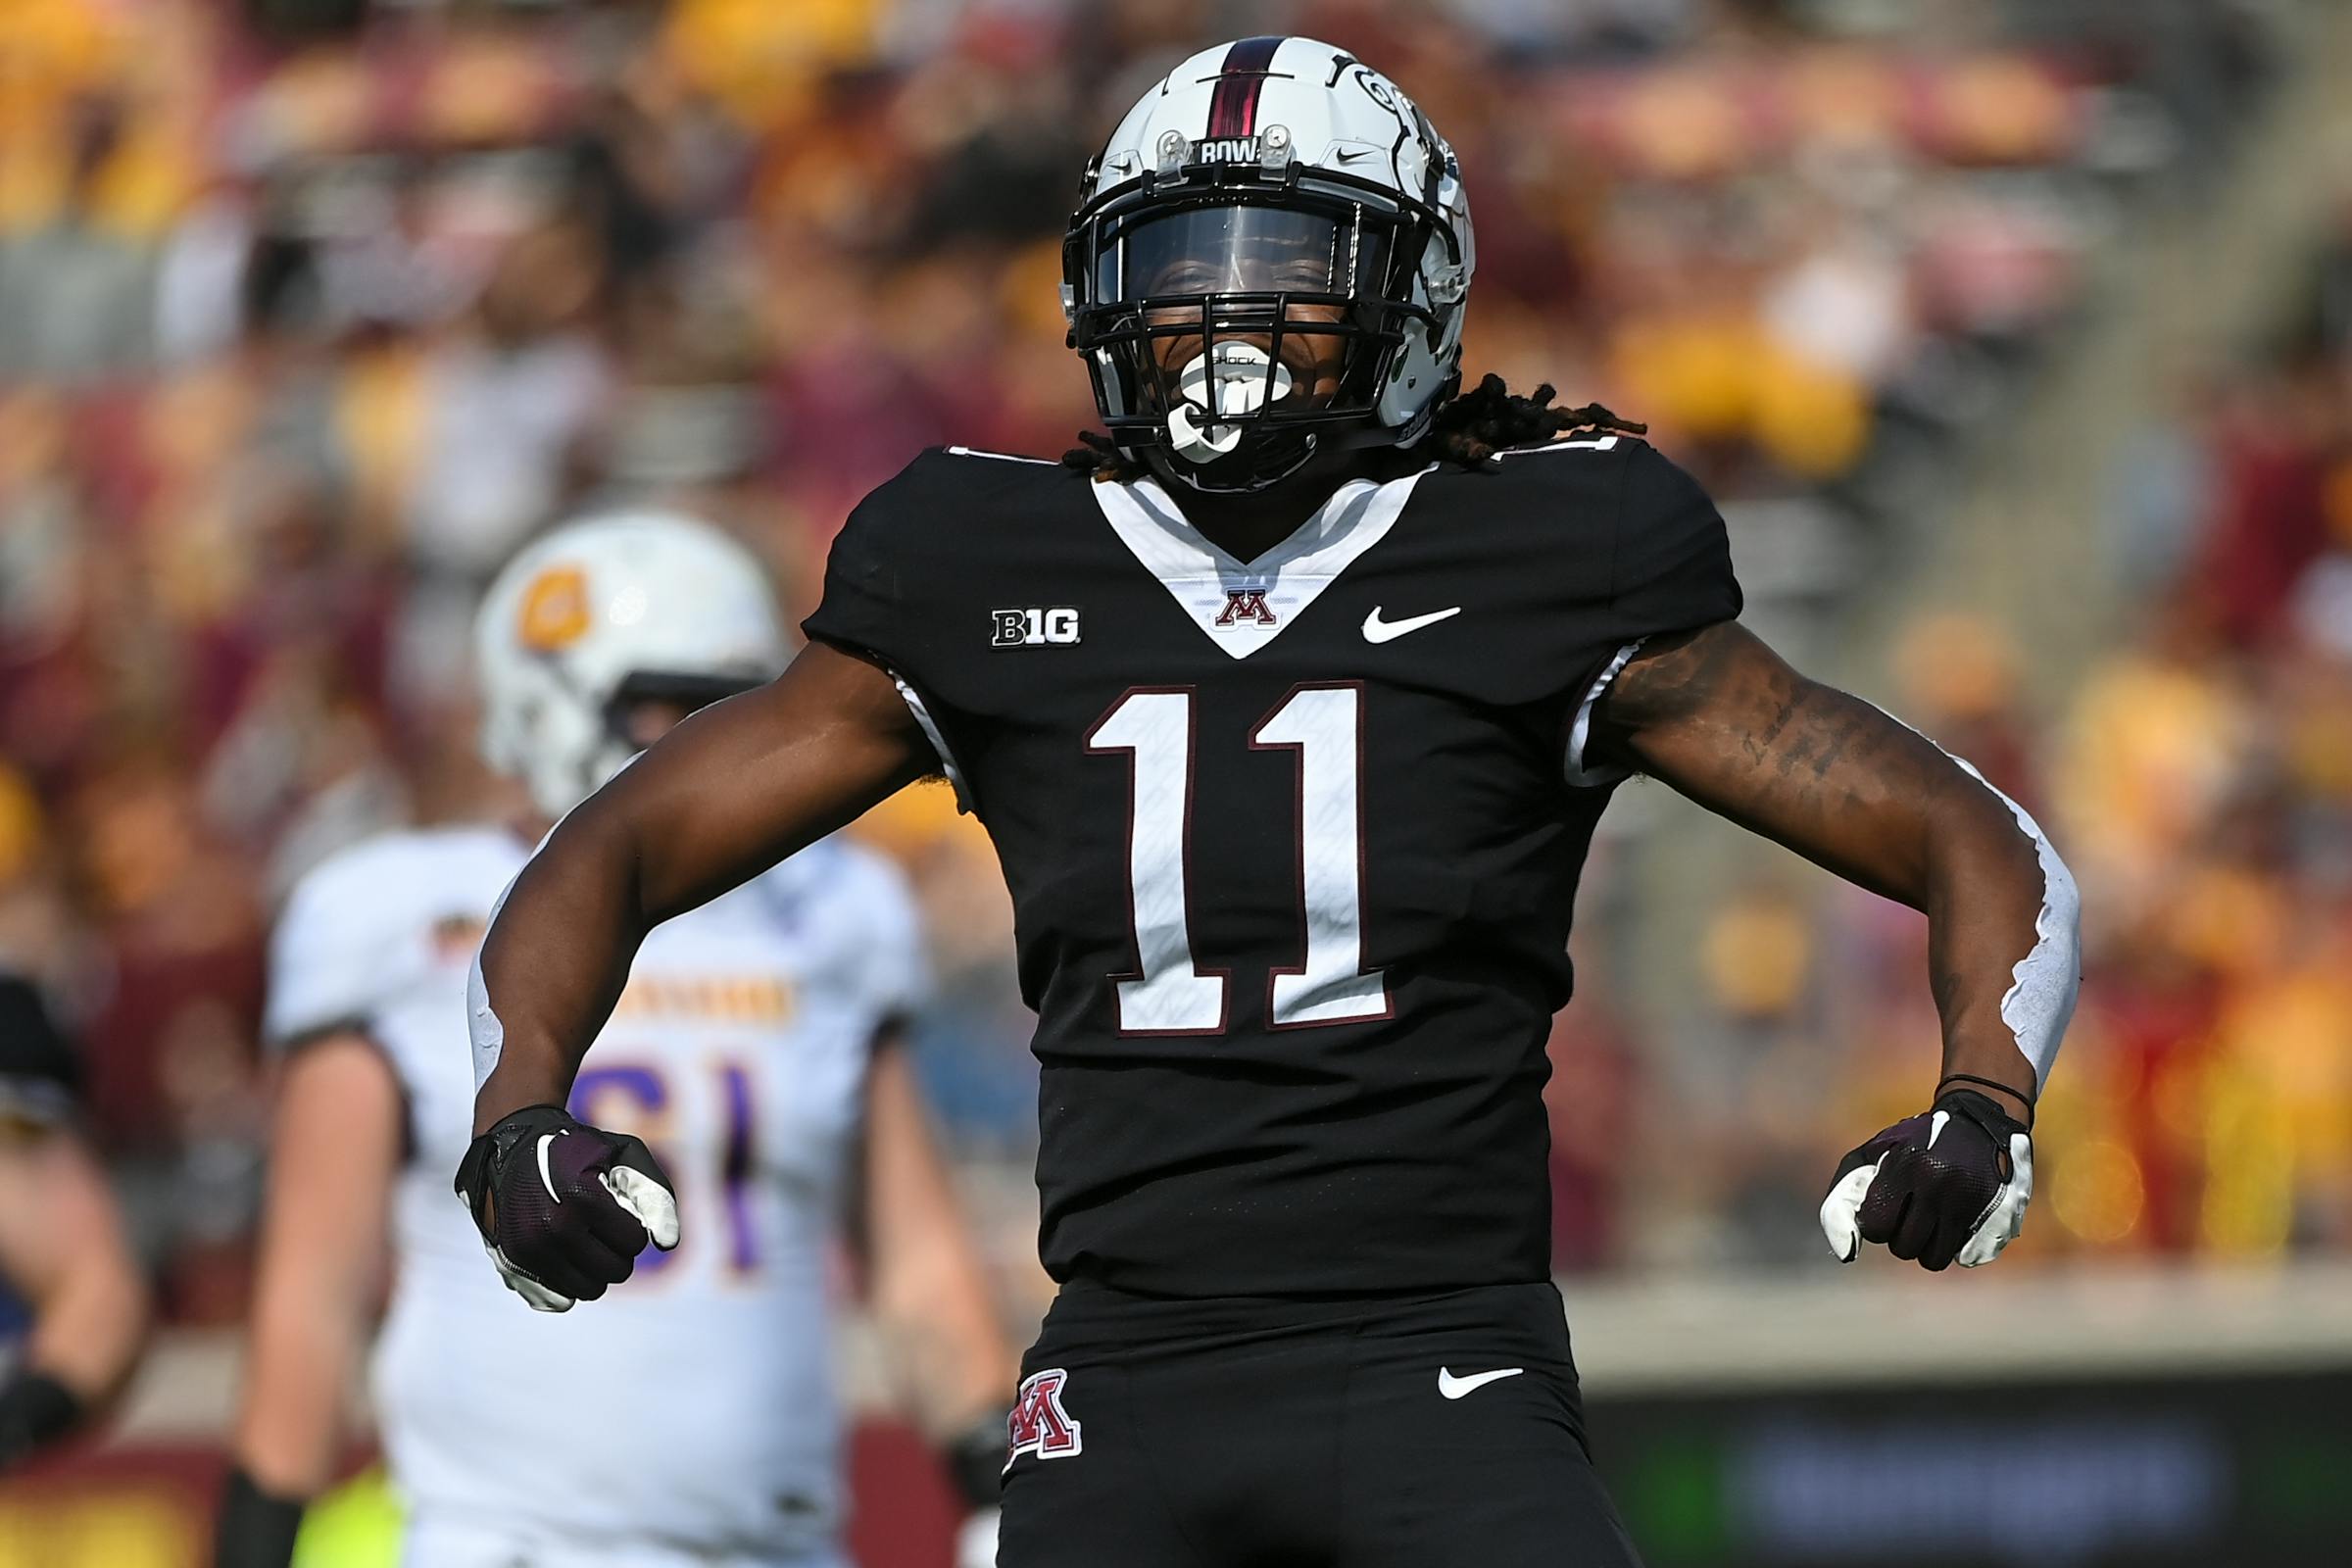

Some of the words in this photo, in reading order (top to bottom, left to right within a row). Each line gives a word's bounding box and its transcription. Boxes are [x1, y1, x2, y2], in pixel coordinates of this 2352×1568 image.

[1200, 137, 1257, 164] ROW
[1215, 589, 1277, 626] M
[1083, 680, 1395, 1039] 11
